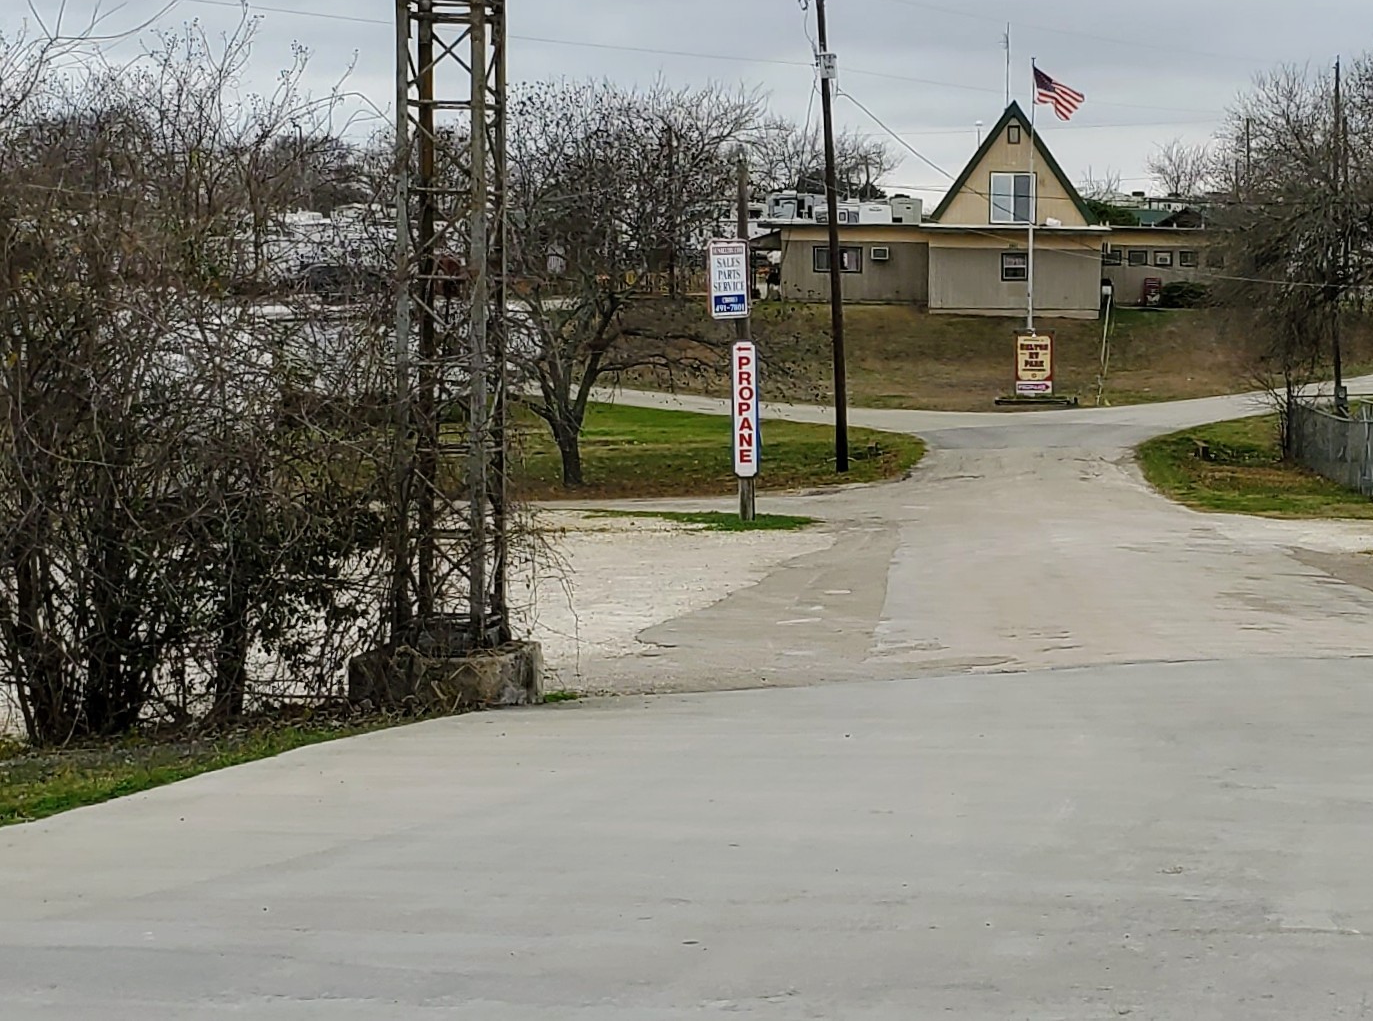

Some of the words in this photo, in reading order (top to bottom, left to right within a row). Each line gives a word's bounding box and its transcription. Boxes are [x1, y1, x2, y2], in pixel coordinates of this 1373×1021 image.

[716, 257, 741, 268] SALES
[717, 269, 741, 280] PARTS
[713, 281, 745, 292] SERVICE
[738, 355, 753, 464] PROPANE
